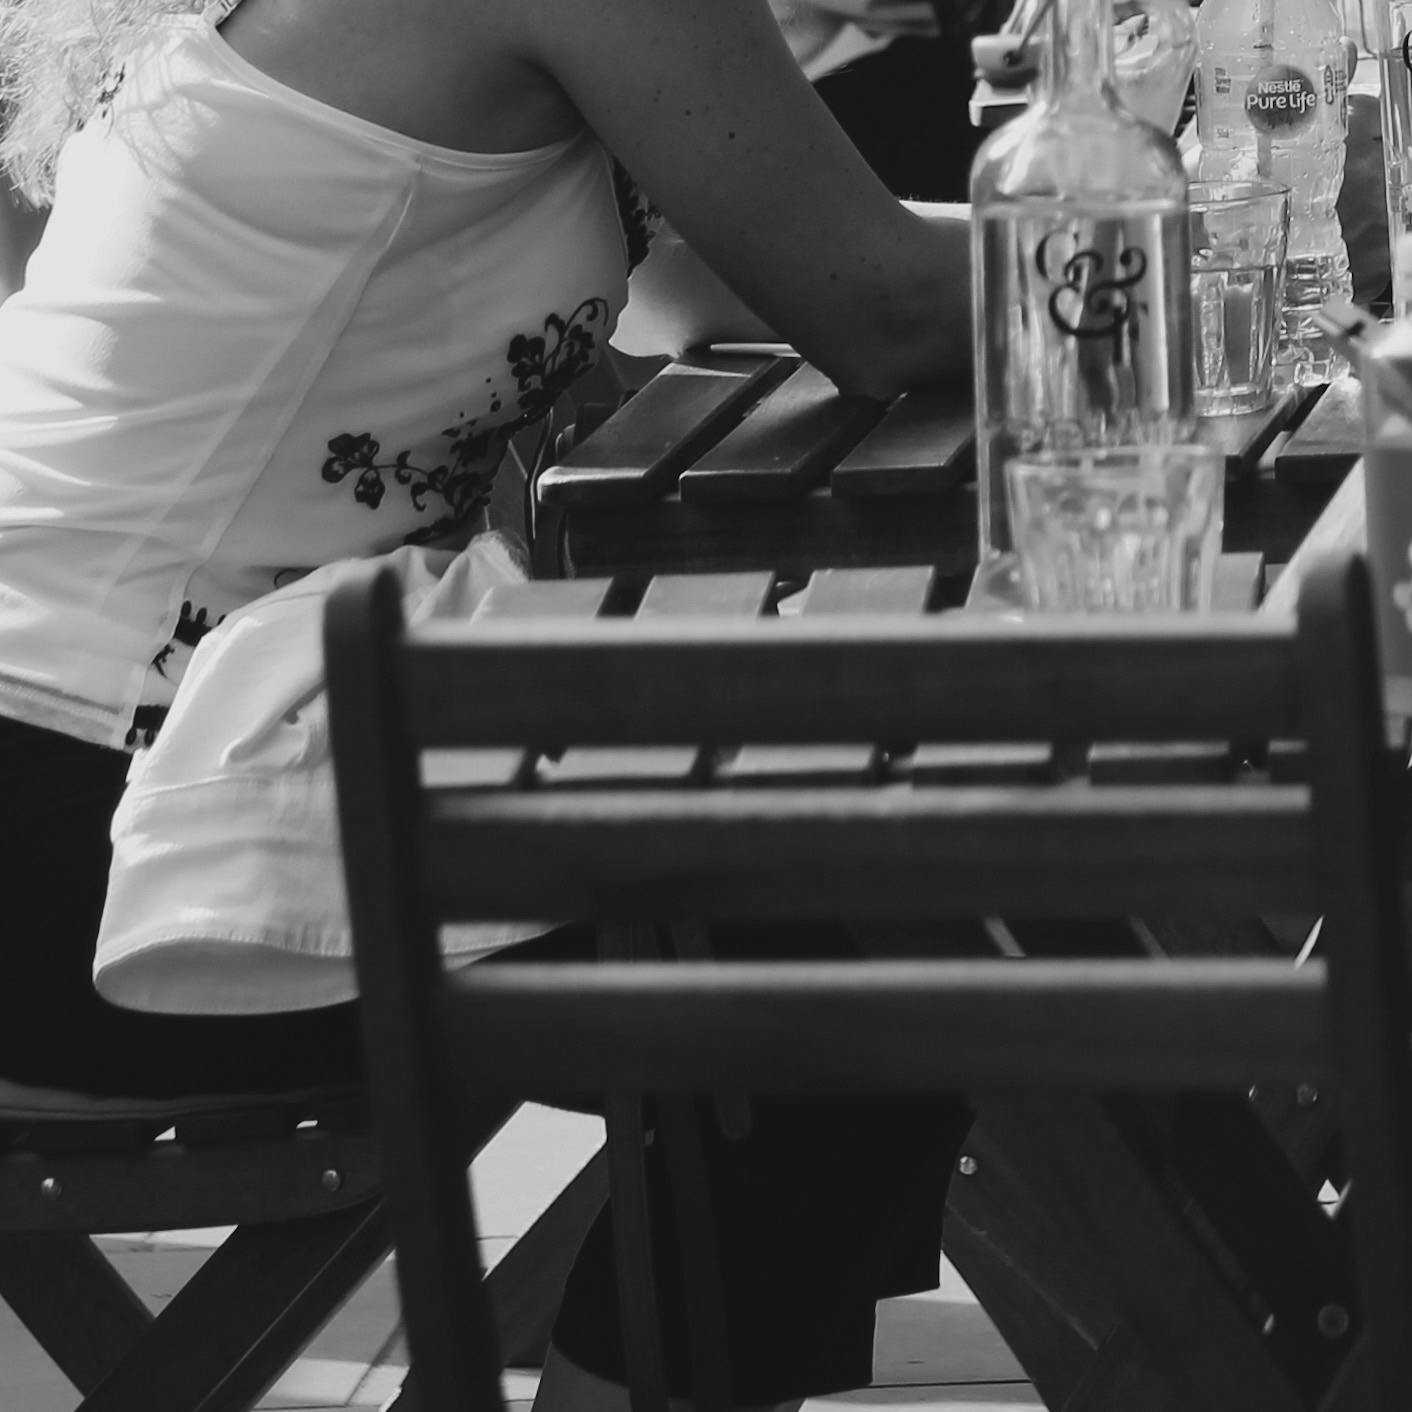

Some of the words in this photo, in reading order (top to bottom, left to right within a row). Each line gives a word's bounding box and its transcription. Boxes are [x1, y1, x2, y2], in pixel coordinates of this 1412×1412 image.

[1257, 78, 1302, 94] Nestlé
[1246, 94, 1287, 110] Pure
[1289, 91, 1317, 114] Life
